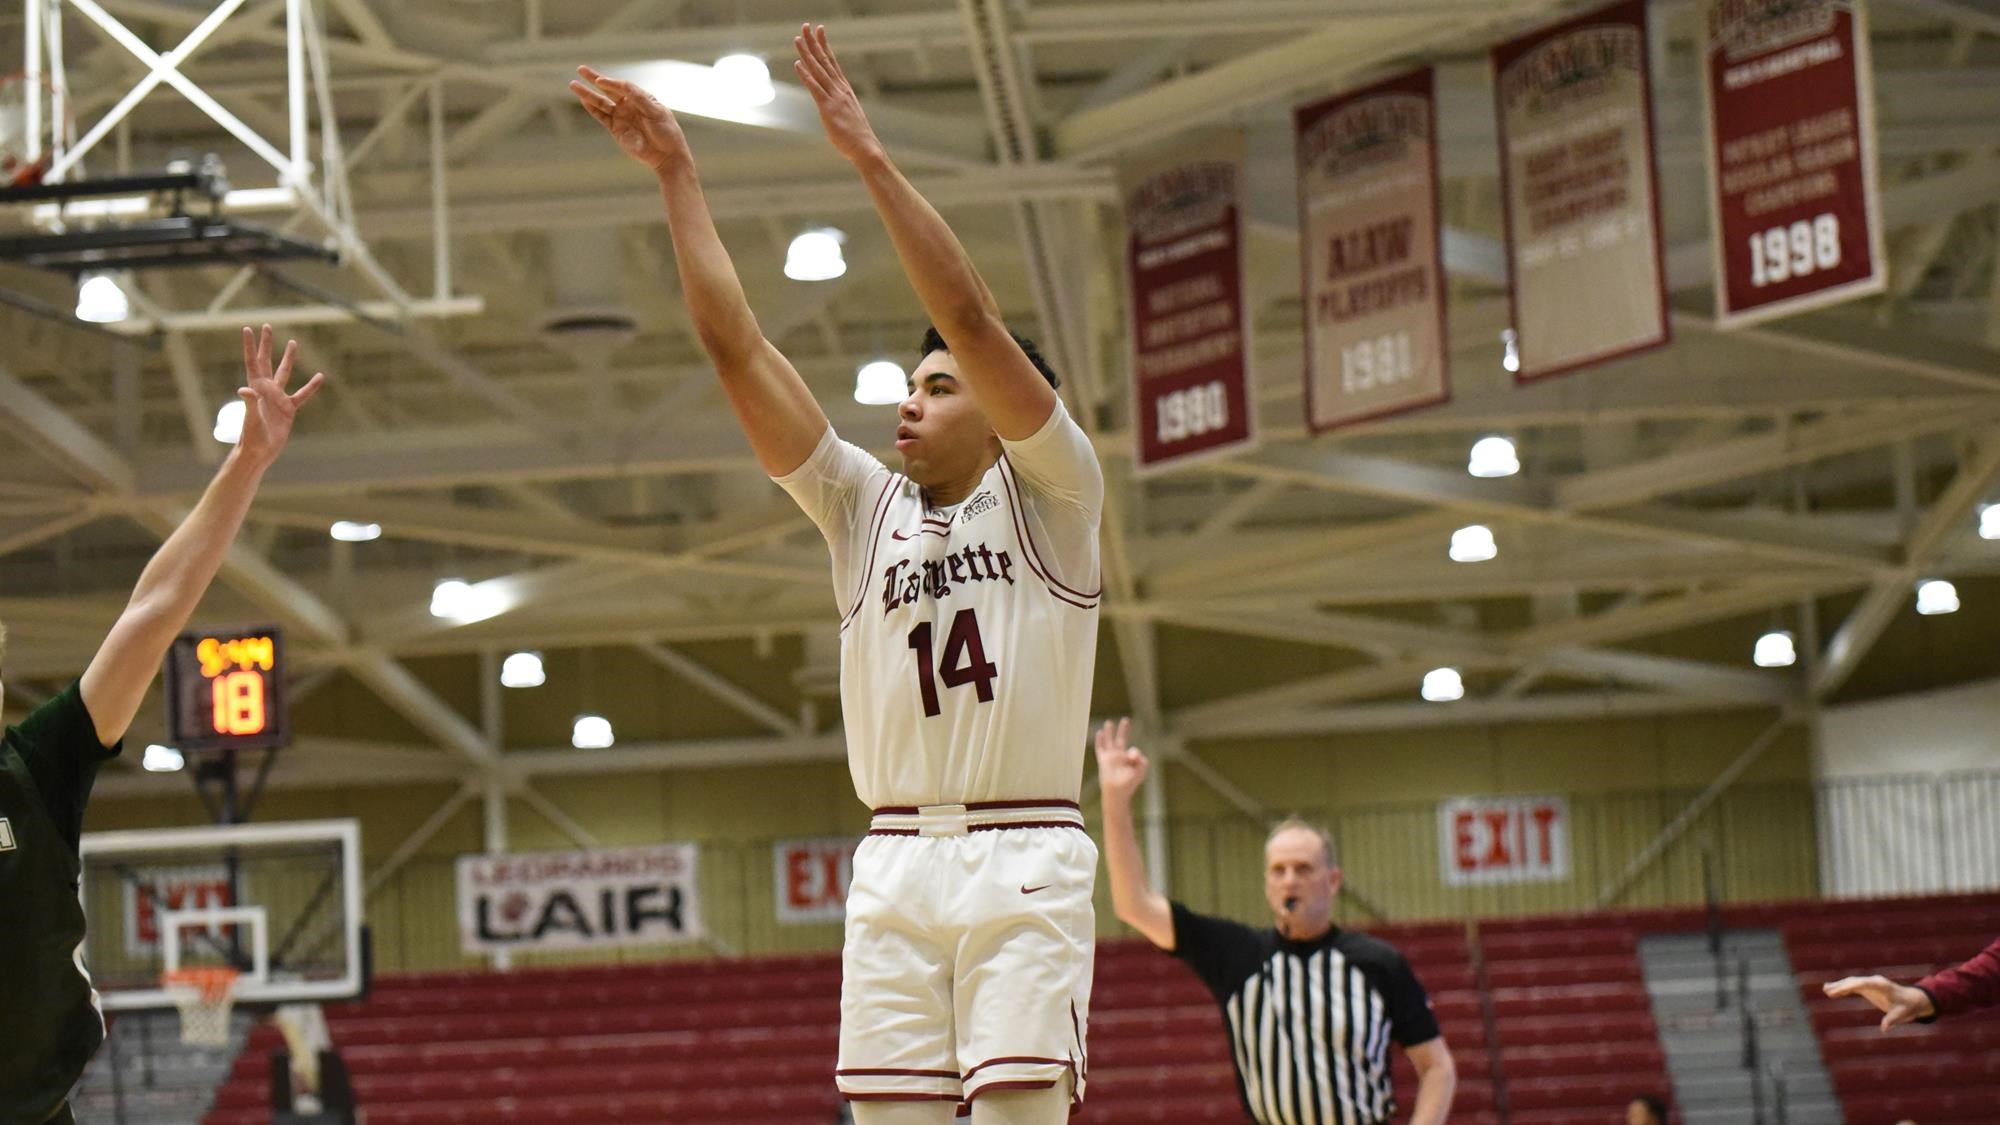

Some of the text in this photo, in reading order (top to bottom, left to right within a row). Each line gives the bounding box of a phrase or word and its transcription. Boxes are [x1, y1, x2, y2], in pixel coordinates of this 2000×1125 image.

[1749, 213, 1840, 287] 1998
[908, 607, 998, 717] 14
[212, 671, 265, 735] 18
[1454, 805, 1557, 872] EXIT
[786, 848, 852, 909] EX
[473, 884, 685, 943] LAIR
